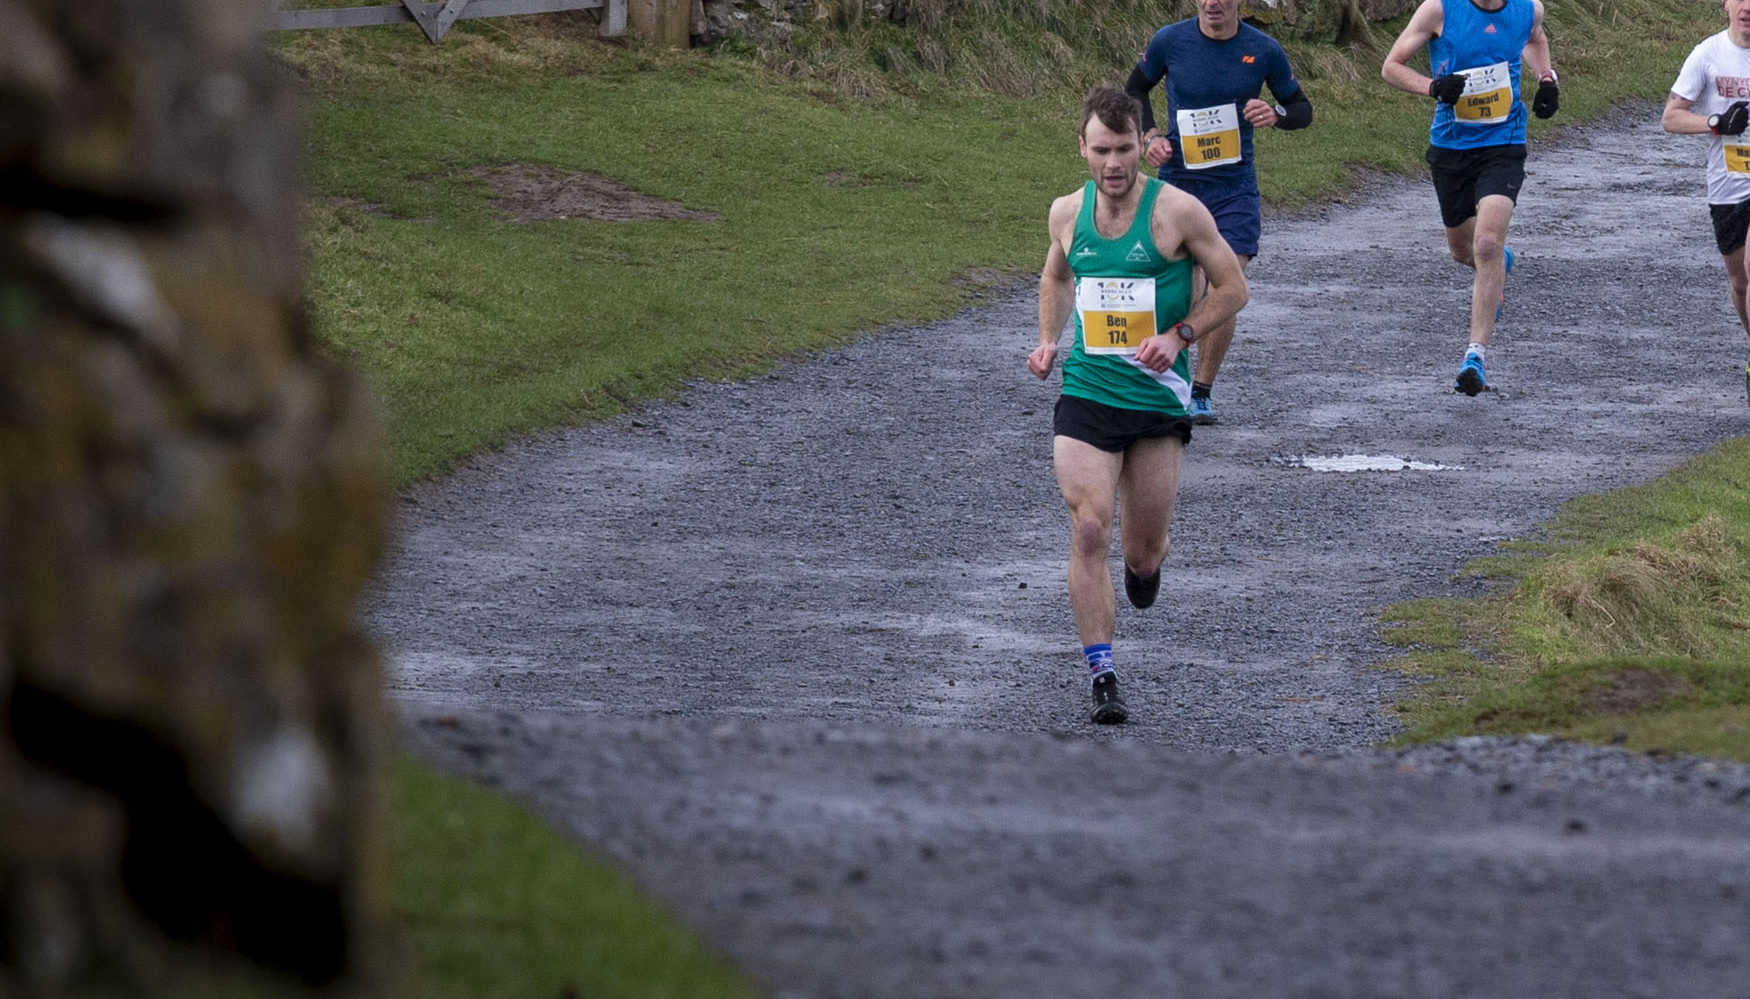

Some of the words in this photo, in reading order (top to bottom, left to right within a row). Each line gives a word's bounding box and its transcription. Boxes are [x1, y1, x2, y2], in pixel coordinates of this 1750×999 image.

[1718, 86, 1734, 98] DE
[1468, 92, 1499, 106] Edward
[1197, 136, 1221, 148] Marc
[1201, 147, 1221, 160] 100
[1106, 315, 1127, 327] Ben
[1107, 330, 1128, 345] 174
